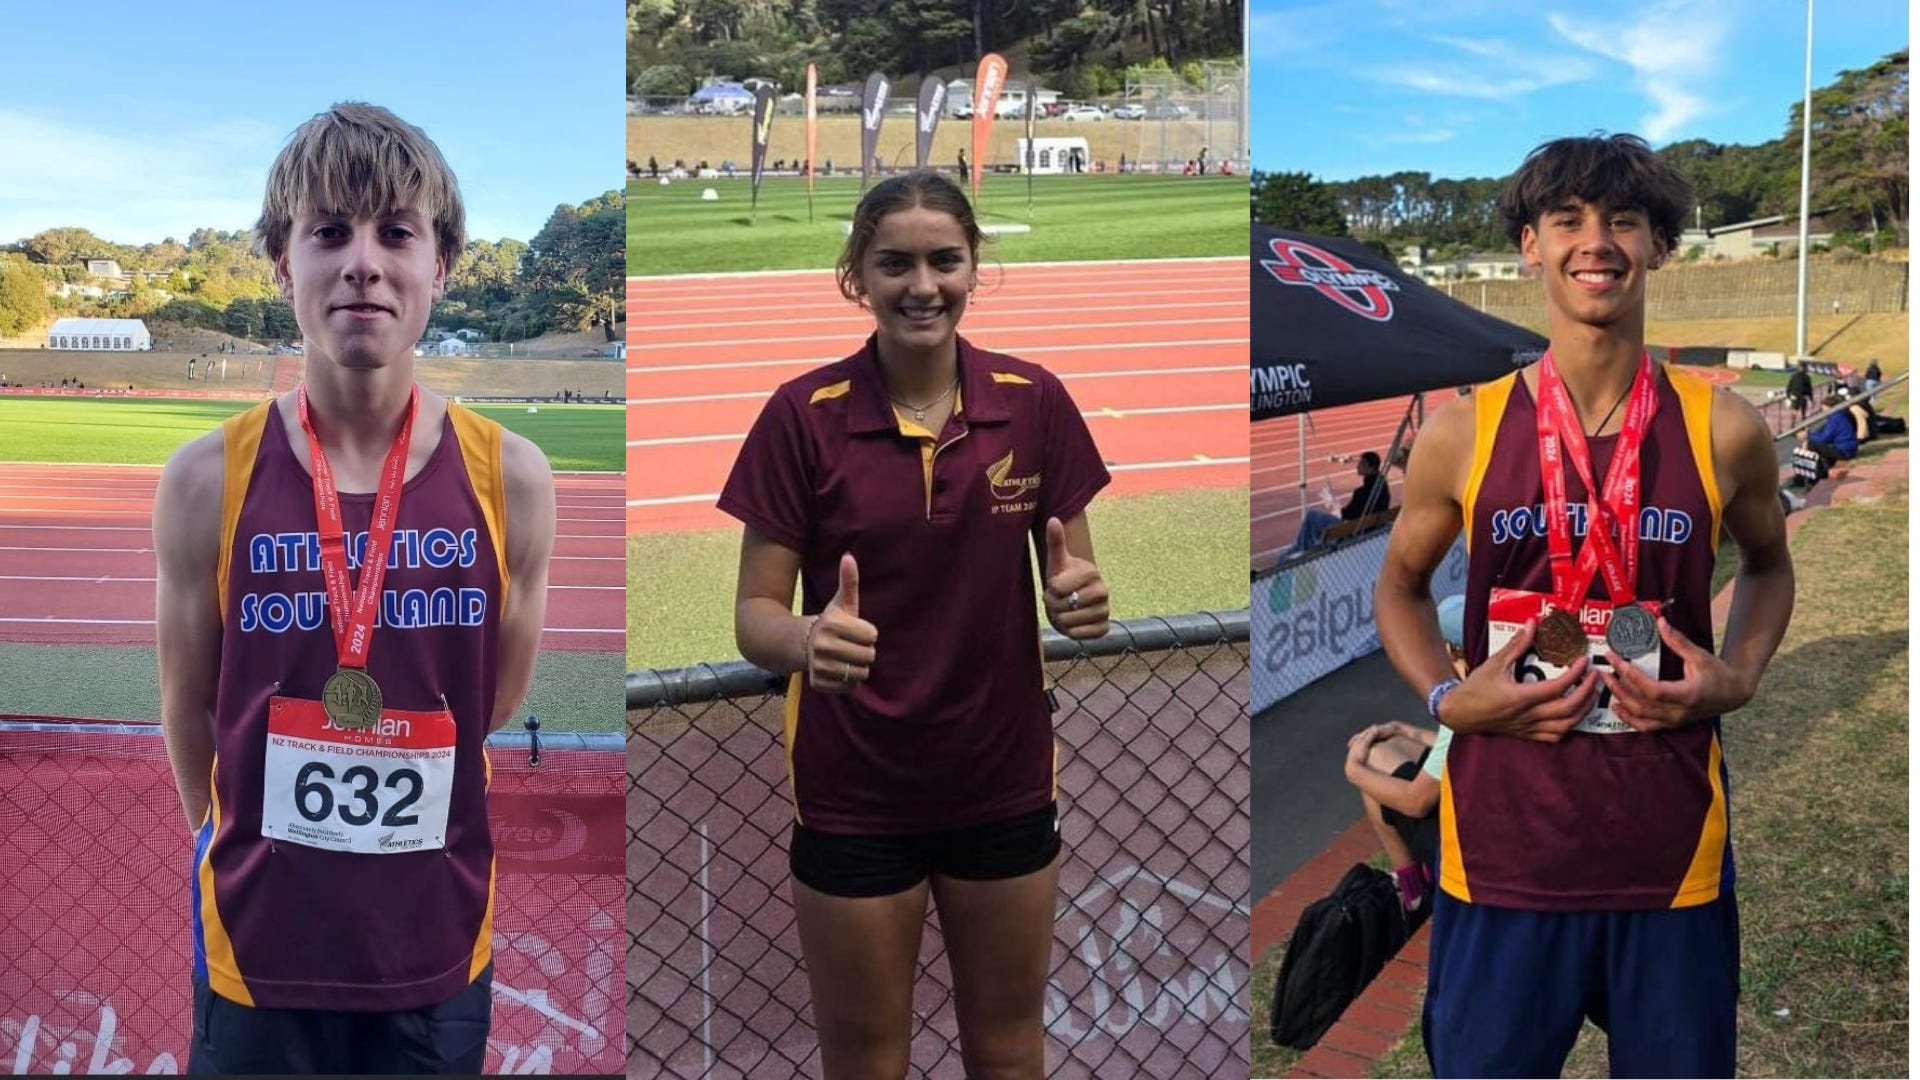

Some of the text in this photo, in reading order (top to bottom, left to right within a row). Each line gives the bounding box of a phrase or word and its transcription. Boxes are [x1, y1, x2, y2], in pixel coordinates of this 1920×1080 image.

[1000, 502, 1022, 513] TEAM
[1492, 503, 1693, 544] SOUHND
[241, 587, 487, 633] SOULAND
[1536, 598, 1614, 625] Jeian
[350, 623, 366, 655] 2024
[1514, 652, 1632, 709] 67
[321, 714, 411, 737] Jian
[272, 737, 451, 760] NZ TRACK & FIELD CHAMPIONSHIPS 2024
[344, 735, 392, 745] HOMES
[295, 761, 424, 826] 632
[387, 838, 423, 848] ATHLETICS
